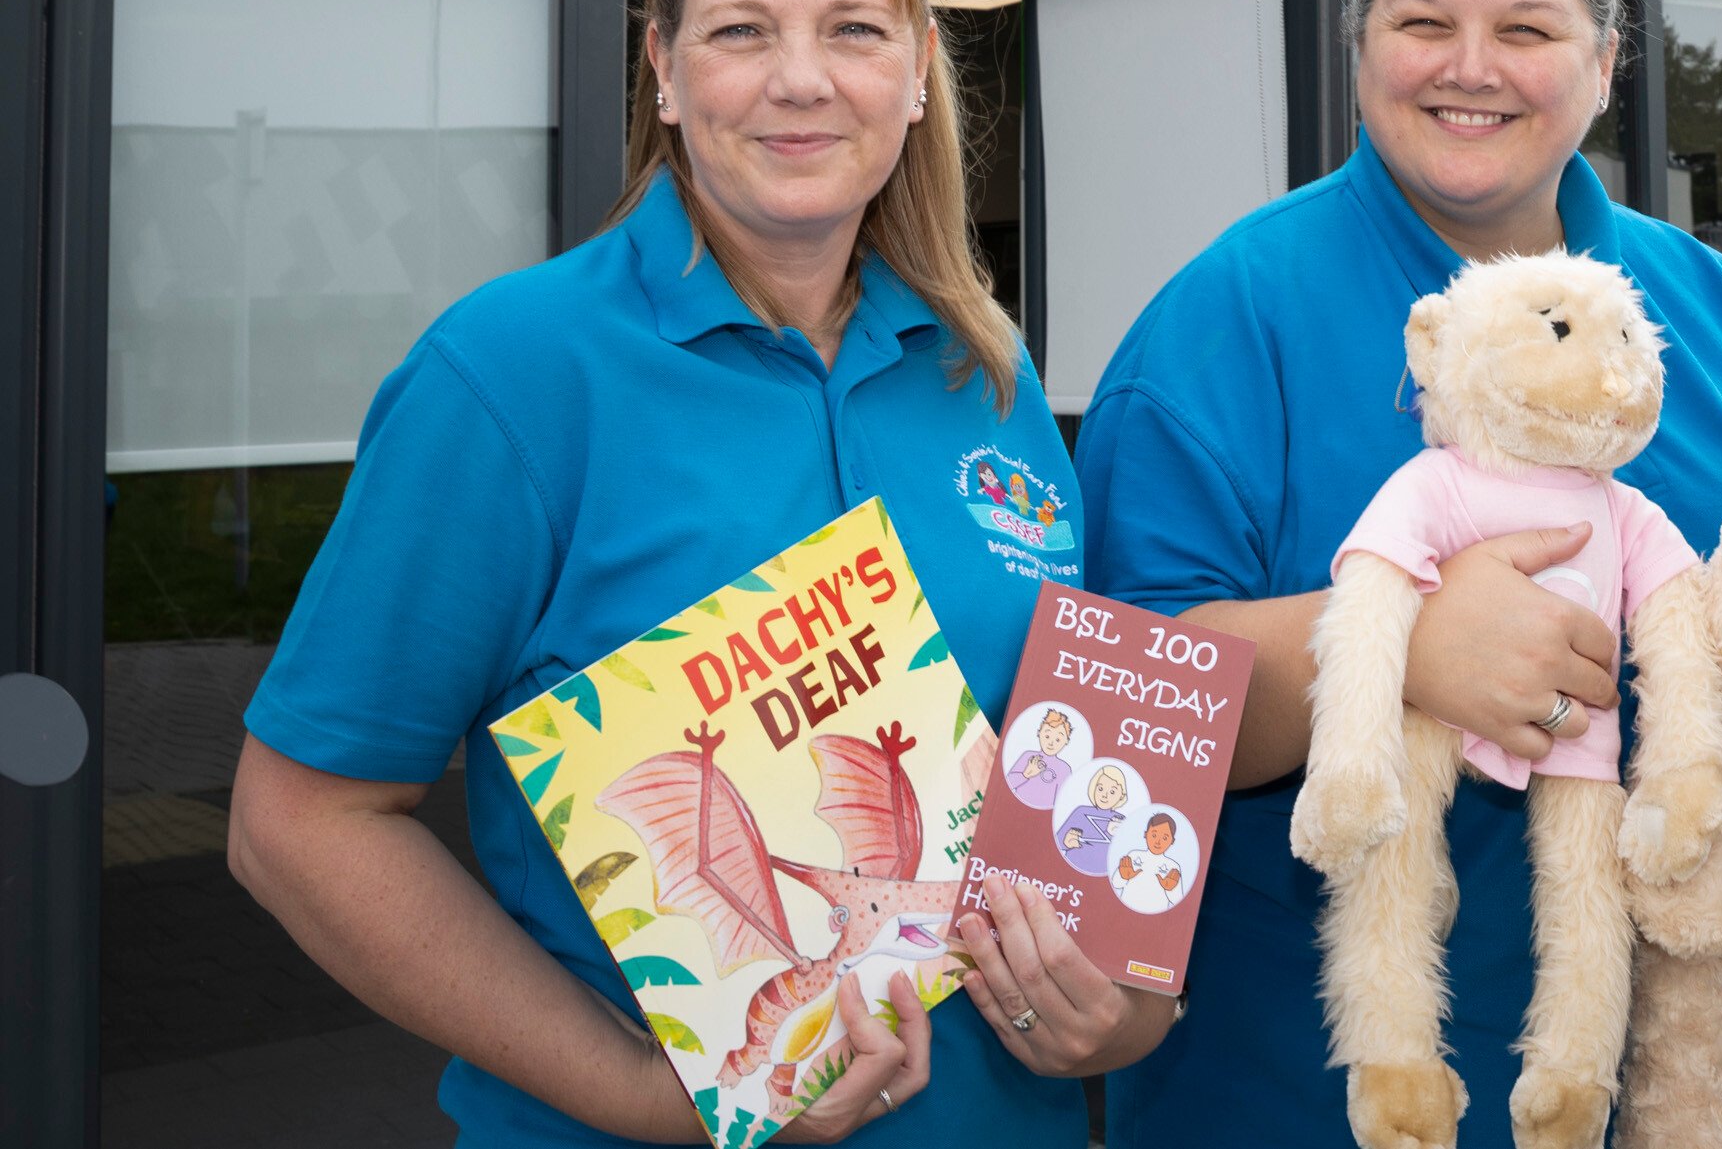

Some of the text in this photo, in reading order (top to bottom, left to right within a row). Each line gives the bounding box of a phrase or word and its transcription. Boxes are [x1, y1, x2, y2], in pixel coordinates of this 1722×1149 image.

[991, 509, 1045, 546] CSSEF
[1005, 560, 1017, 573] of
[1050, 562, 1079, 576] lives
[680, 546, 897, 716] DACHY'S
[1054, 597, 1219, 672] BSL 100
[750, 623, 886, 752] DEAF
[1053, 650, 1228, 723] EVERYDAY
[1117, 717, 1216, 768] SIGNS
